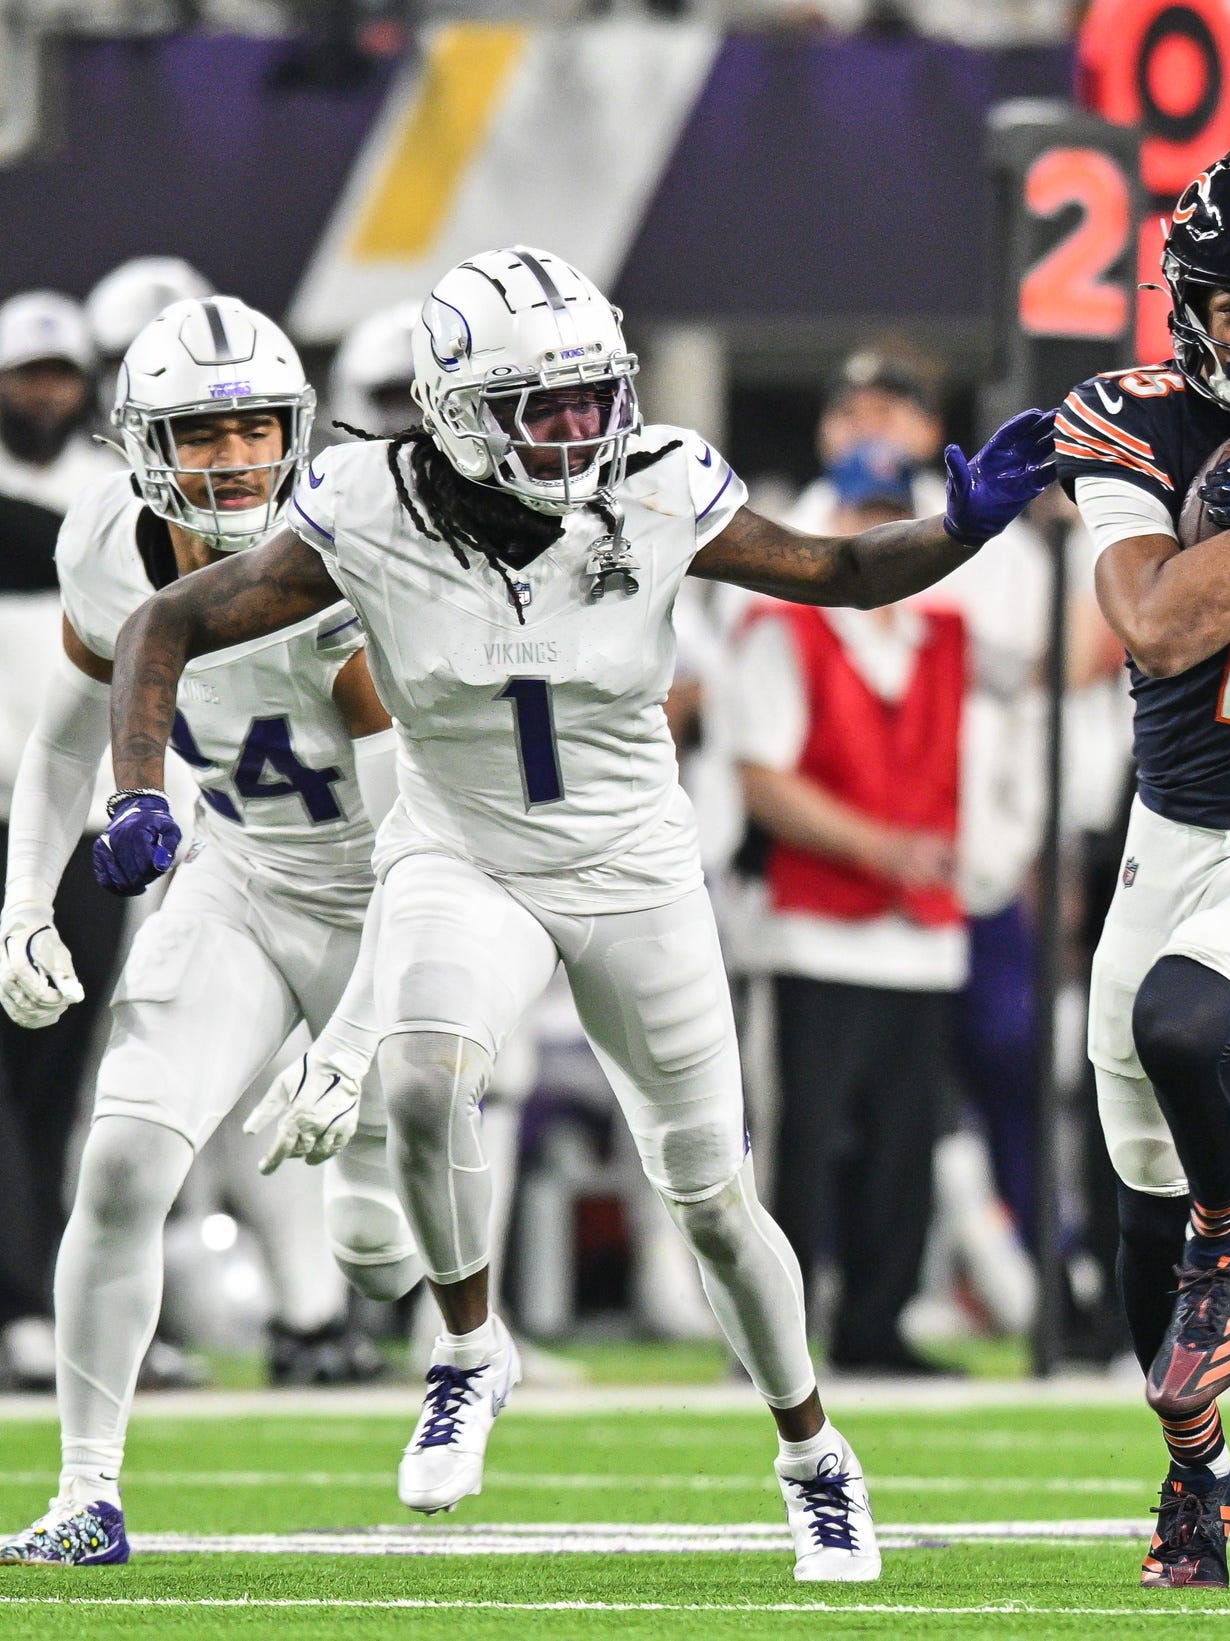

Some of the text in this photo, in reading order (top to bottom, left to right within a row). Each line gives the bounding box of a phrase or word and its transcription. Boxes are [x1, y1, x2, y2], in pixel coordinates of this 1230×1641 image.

[1020, 147, 1129, 338] 2
[483, 641, 559, 665] VIKINGS
[491, 674, 566, 816] 1
